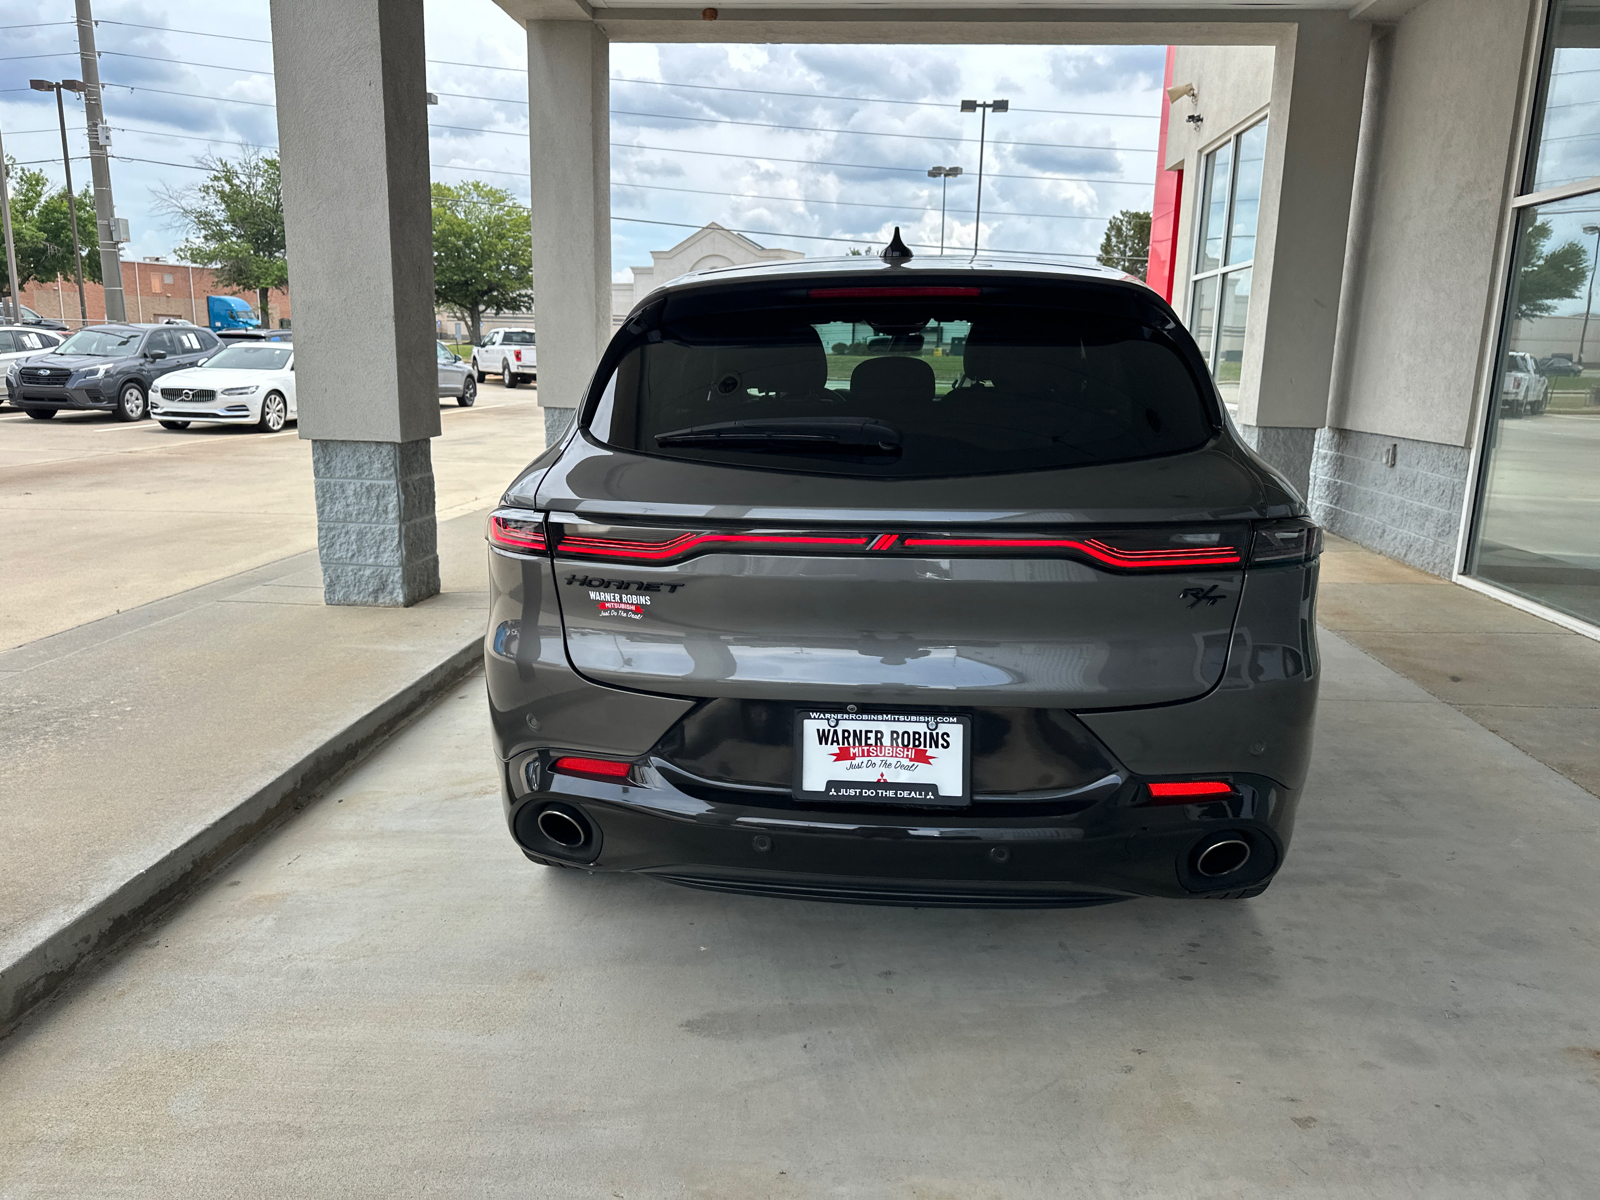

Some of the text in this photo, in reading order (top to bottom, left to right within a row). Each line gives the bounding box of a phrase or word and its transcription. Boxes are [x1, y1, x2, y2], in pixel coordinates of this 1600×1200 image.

[564, 574, 685, 593] HORNET
[589, 591, 651, 605] WARNER ROBINS
[816, 728, 950, 749] WARNER ROBINS
[850, 746, 915, 759] MITSUBISHI
[846, 759, 919, 772] Just Do The Deal!
[838, 788, 861, 796] JUST
[862, 789, 876, 797] DO
[897, 790, 925, 799] DEAL!
